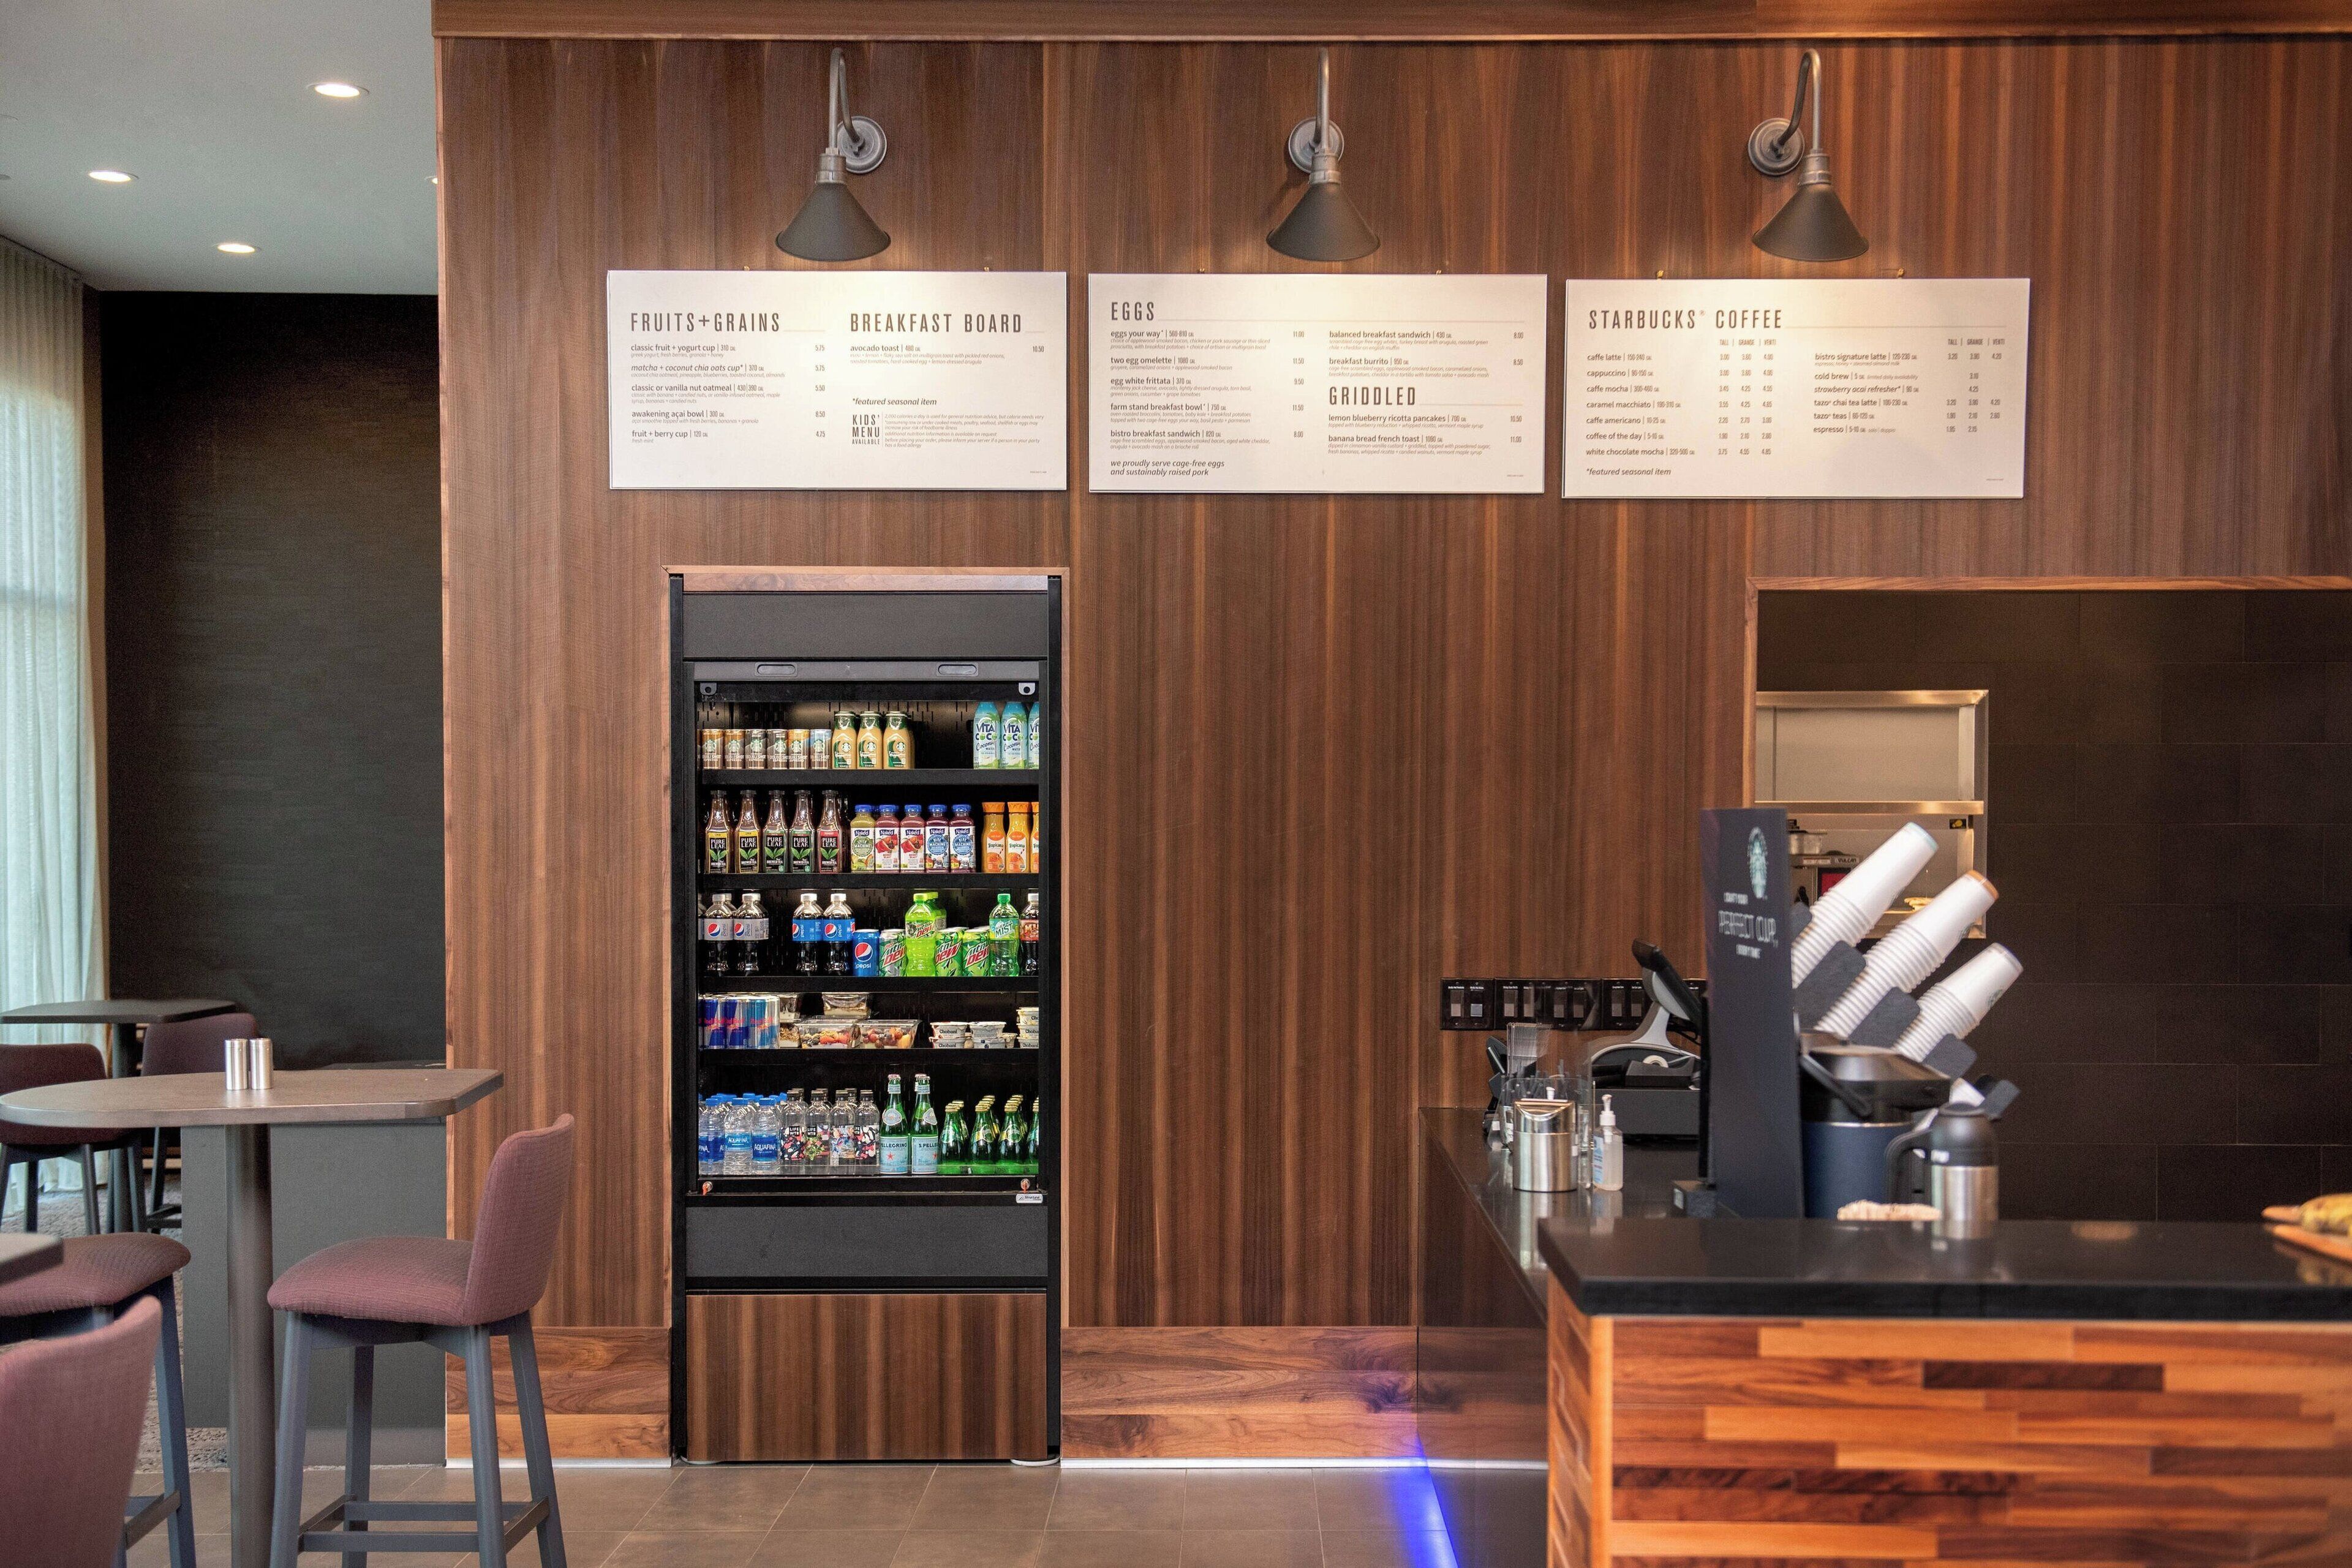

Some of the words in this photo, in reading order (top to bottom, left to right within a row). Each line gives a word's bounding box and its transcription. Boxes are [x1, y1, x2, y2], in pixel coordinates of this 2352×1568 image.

[1112, 302, 1153, 321] EGGS
[851, 314, 952, 332] BREAKFAST
[965, 314, 1020, 333] BOARD
[1716, 310, 1781, 328] COFFEE
[1330, 386, 1415, 405] GRIDDLED
[632, 410, 669, 419] awakening
[1353, 414, 1387, 424] blueberry
[1413, 415, 1446, 423] pancakes
[655, 430, 673, 439] berry
[853, 427, 879, 437] MENU
[1629, 432, 1642, 441] day
[1123, 459, 1150, 468] proudly
[976, 723, 995, 732] VITA
[1003, 723, 1020, 733] VITA
[996, 924, 1013, 937] MIST
